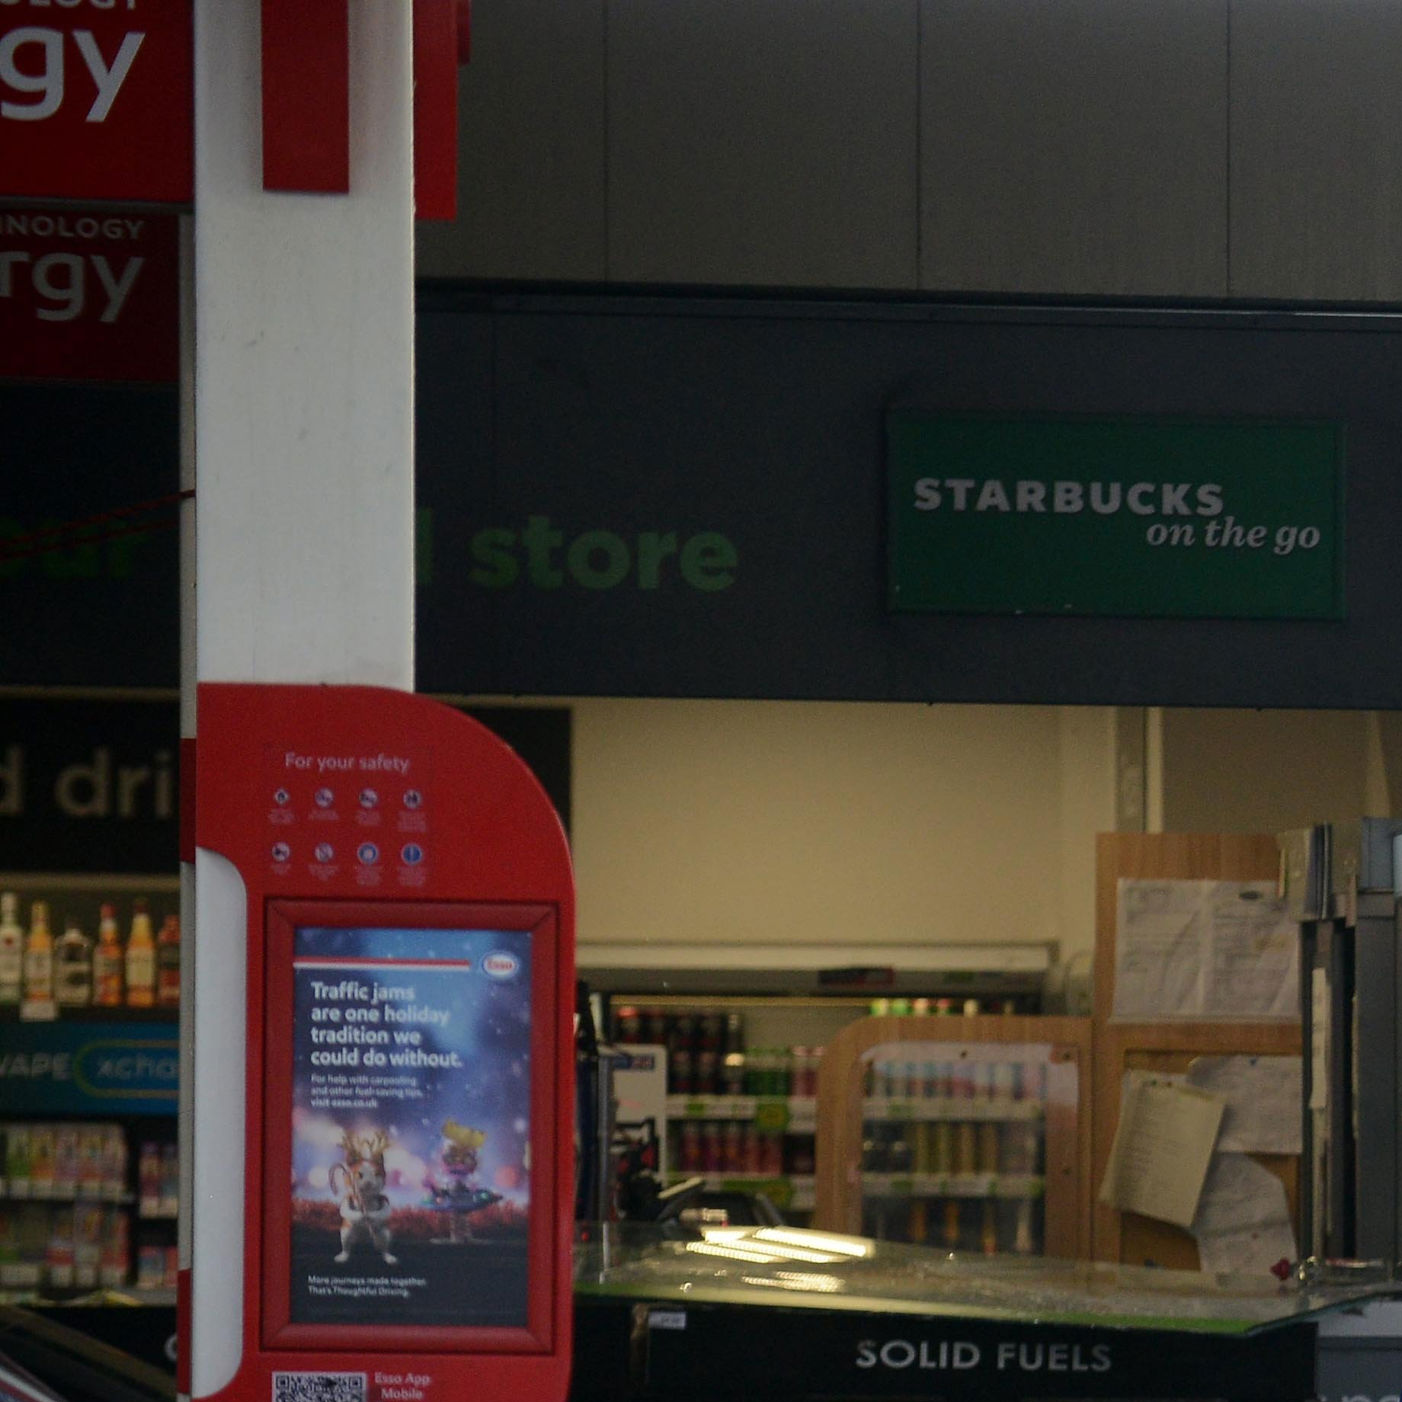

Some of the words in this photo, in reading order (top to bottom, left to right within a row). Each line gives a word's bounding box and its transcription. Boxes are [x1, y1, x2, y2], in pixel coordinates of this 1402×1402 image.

[0, 215, 144, 240] NOLOGY
[913, 478, 1224, 516] STARBUCKS
[1146, 523, 1195, 547] on
[1204, 516, 1267, 549] the
[1273, 525, 1320, 555] go
[469, 515, 739, 592] store
[285, 752, 312, 768] For
[317, 757, 354, 772] your
[358, 753, 410, 775] safety
[55, 746, 174, 822] dri
[310, 981, 368, 1001] Traffic
[370, 983, 416, 1005] jams
[311, 1007, 341, 1022] are
[345, 1007, 380, 1023] one
[384, 1005, 450, 1026] holiday
[310, 1026, 388, 1044] tradition
[394, 1030, 421, 1044] we
[310, 1048, 358, 1066] could
[363, 1050, 386, 1067] do
[390, 1050, 462, 1068] without.
[311, 1074, 325, 1083] For
[328, 1074, 347, 1086] help
[349, 1075, 368, 1084] with
[311, 1086, 328, 1095] and
[329, 1087, 353, 1096] other
[311, 1098, 330, 1107] visit
[855, 1338, 980, 1370] SOLID
[997, 1343, 1112, 1374] FUELS
[374, 1373, 402, 1385] Esso
[405, 1373, 431, 1387] App
[381, 1388, 424, 1400] Mobile
